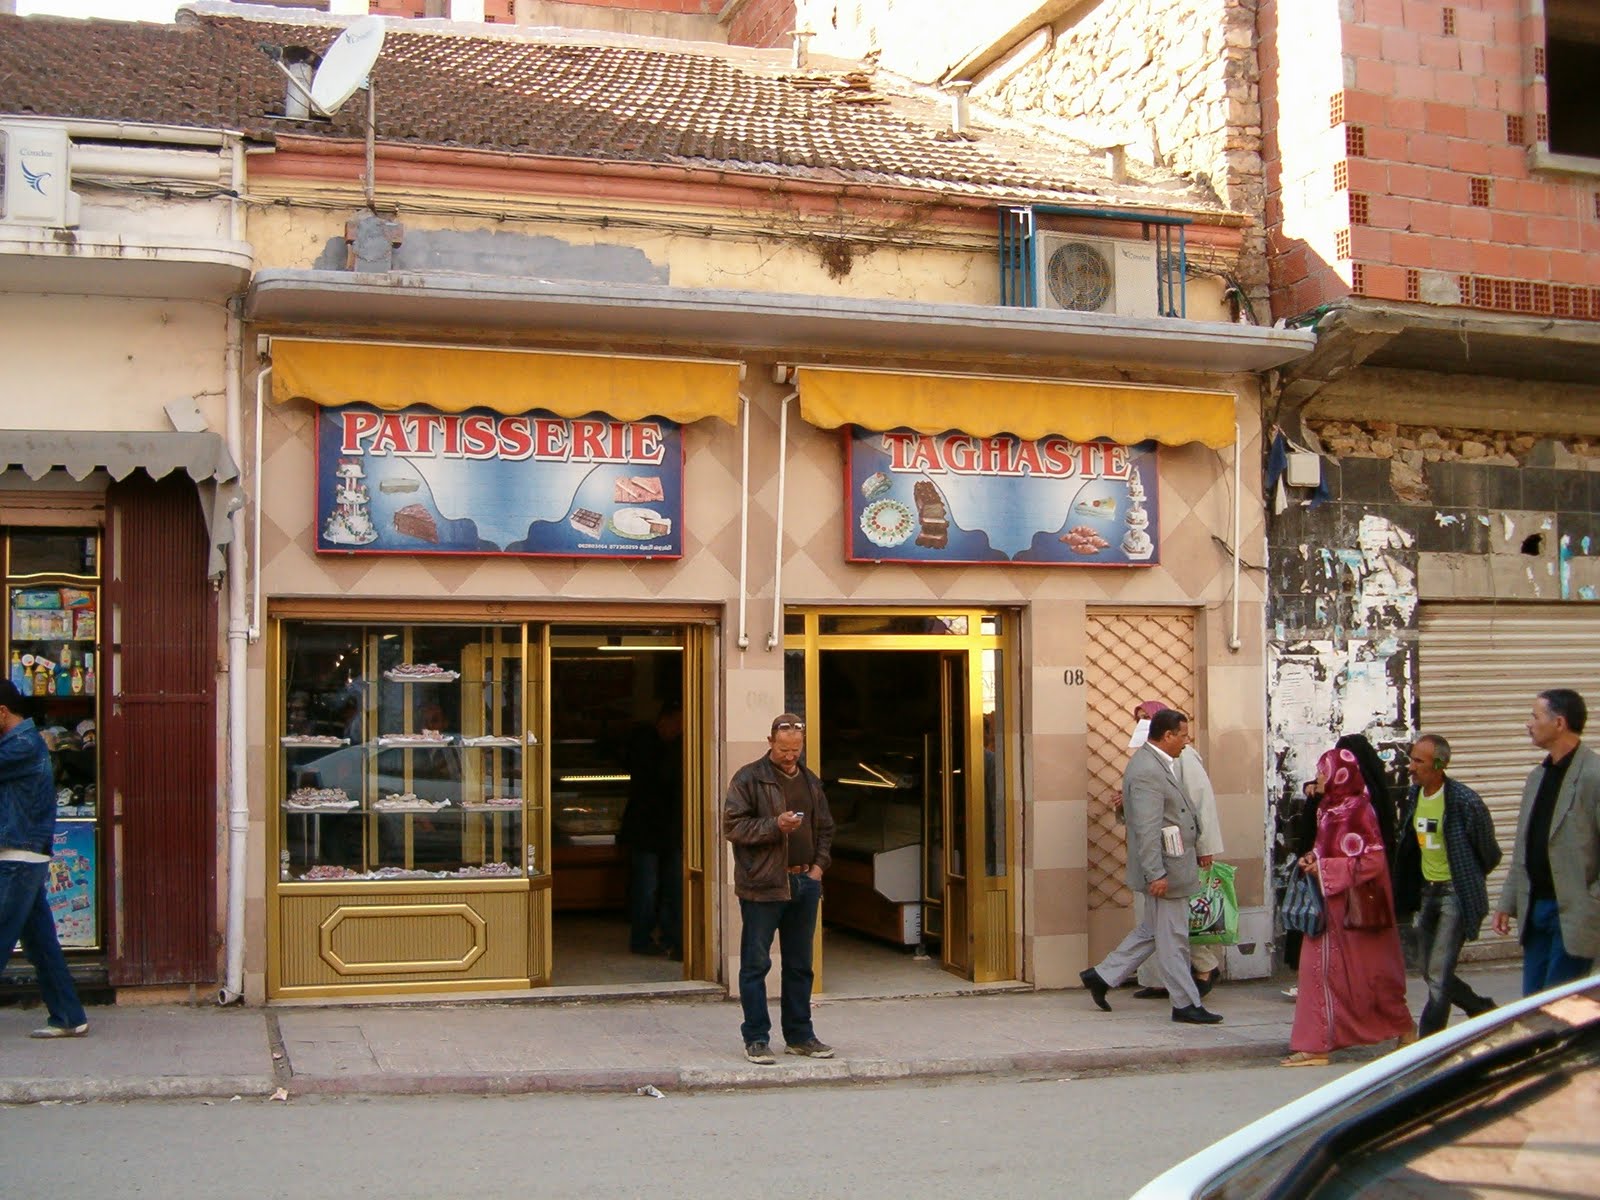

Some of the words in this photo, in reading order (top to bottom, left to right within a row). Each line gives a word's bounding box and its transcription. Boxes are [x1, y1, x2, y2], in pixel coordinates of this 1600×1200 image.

[341, 412, 665, 465] PATISSERIE
[882, 432, 1132, 481] TAGHASTE
[1064, 669, 1085, 686] 08
